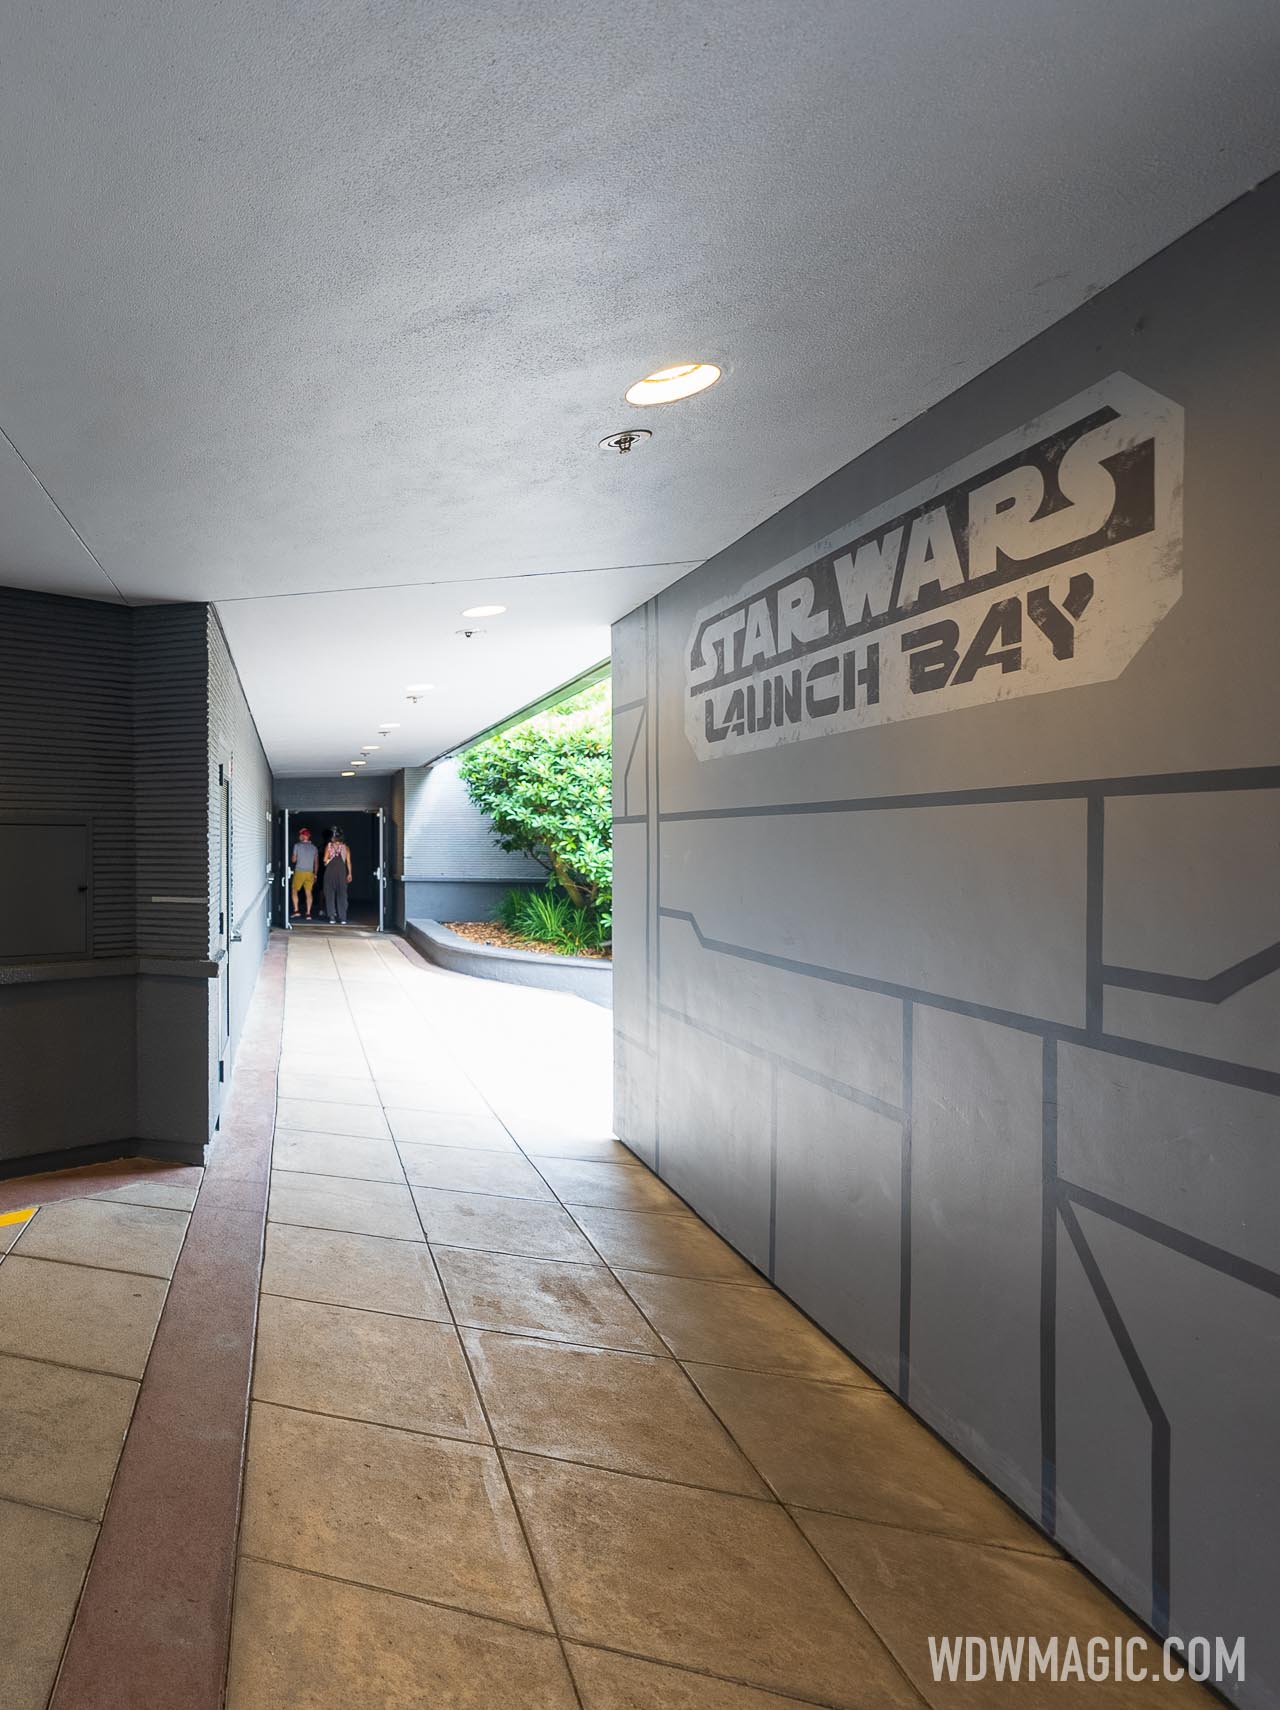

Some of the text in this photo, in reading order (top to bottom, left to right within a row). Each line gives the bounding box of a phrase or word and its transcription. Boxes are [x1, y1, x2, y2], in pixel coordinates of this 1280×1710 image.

[690, 412, 1155, 683] STAR WARS
[705, 572, 1094, 744] LAUNCH BAY
